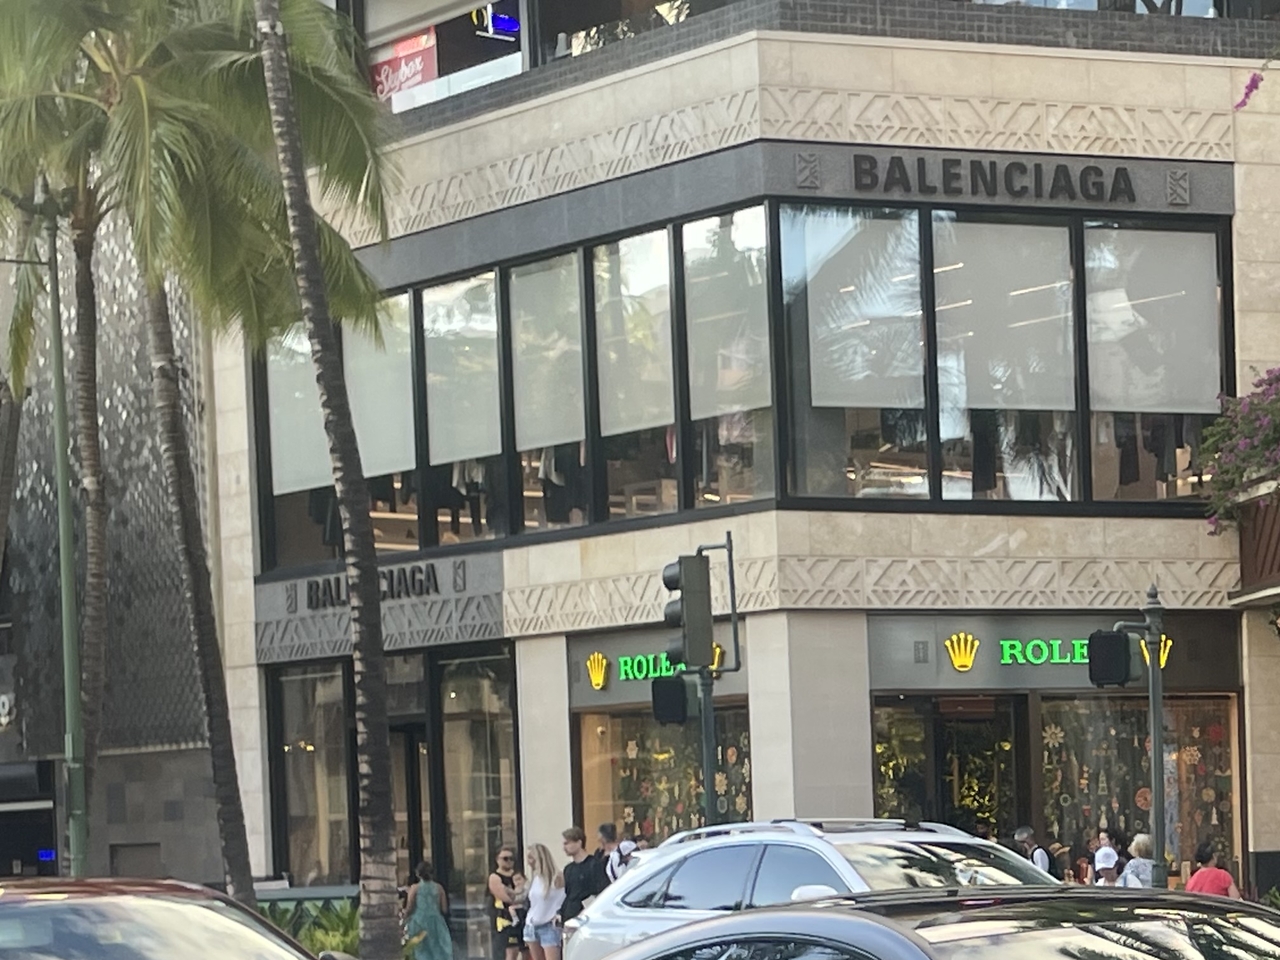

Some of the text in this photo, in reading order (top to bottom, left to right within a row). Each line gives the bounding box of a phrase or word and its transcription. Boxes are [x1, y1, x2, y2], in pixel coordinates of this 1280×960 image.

[375, 55, 424, 101] Skybox
[853, 153, 1136, 202] BALENCIAGA
[306, 563, 440, 611] BALCIAGA
[618, 652, 687, 680] ROLE
[1000, 639, 1090, 665] ROLE
